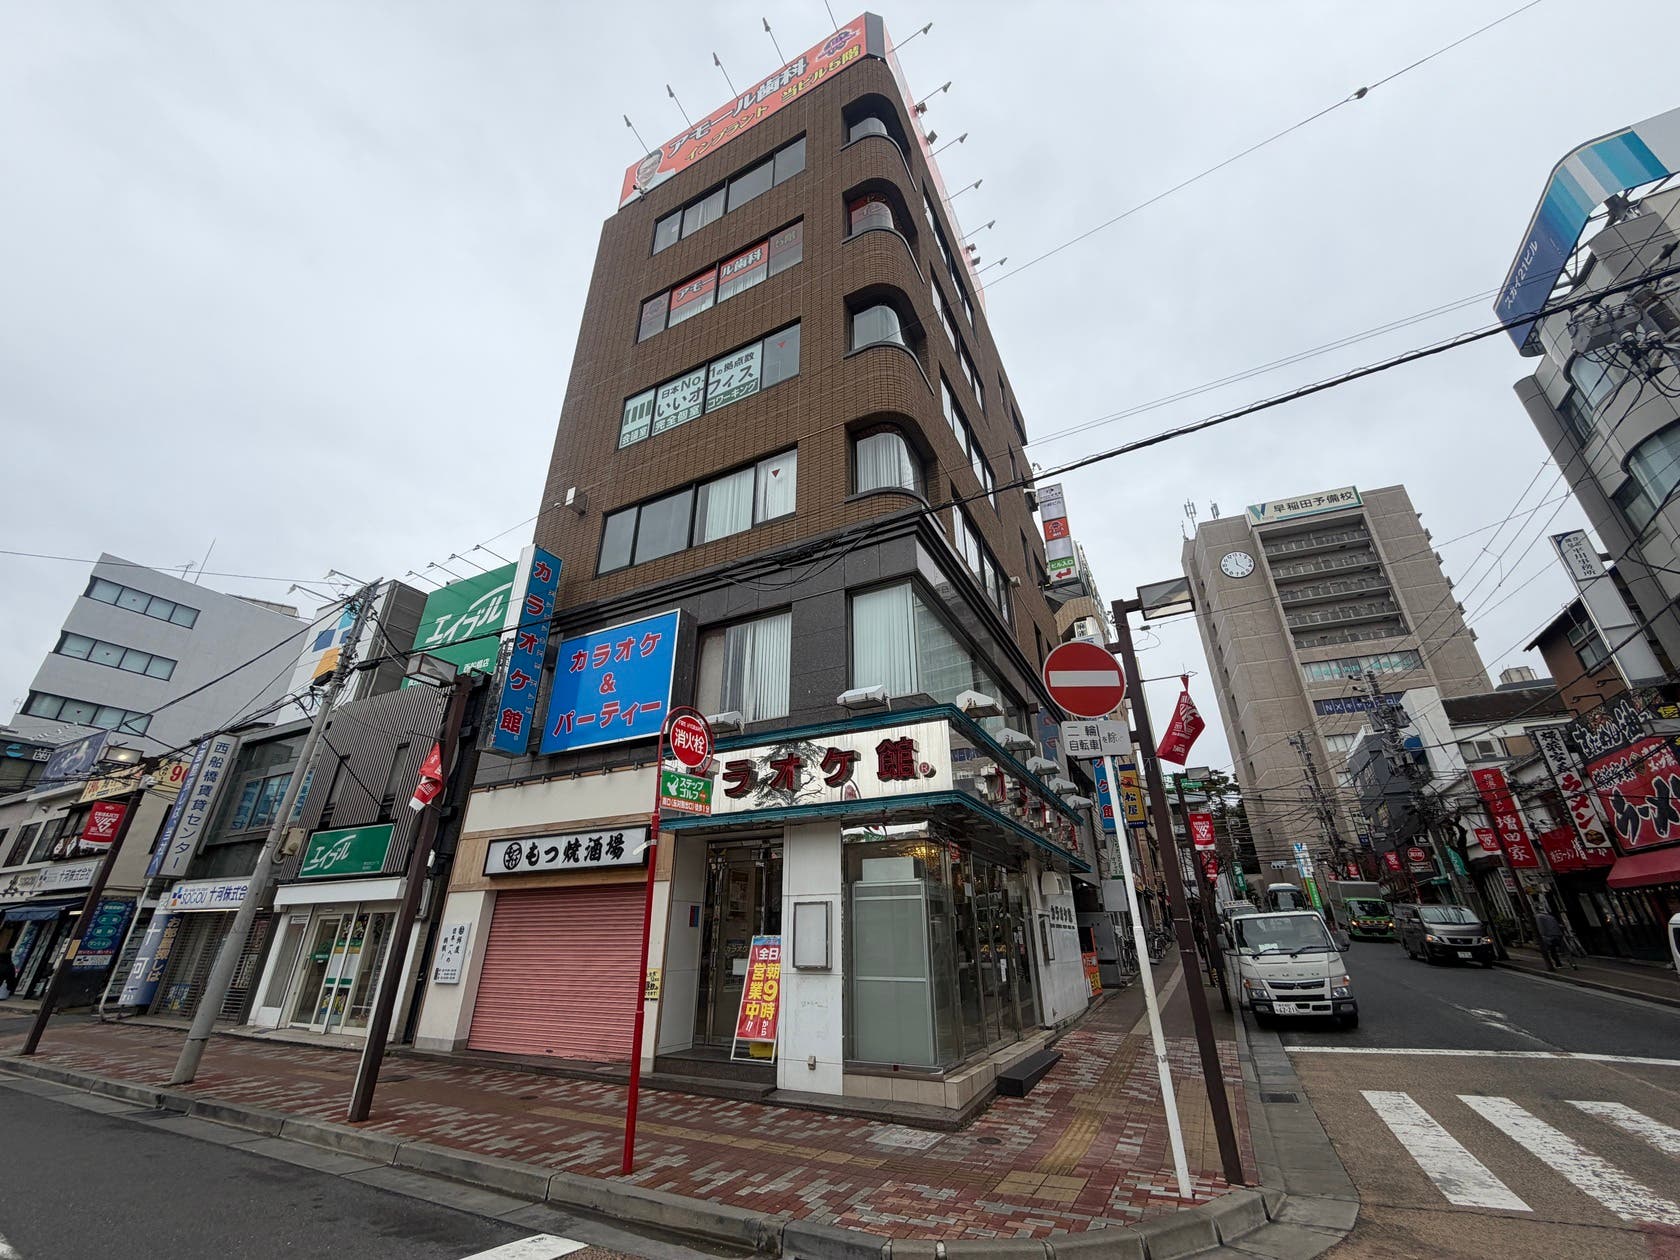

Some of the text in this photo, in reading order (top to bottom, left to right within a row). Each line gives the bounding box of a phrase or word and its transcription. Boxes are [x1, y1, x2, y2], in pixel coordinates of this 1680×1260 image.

[668, 56, 808, 158] アモール歯科
[687, 105, 769, 161] インプラント
[1504, 239, 1538, 310] スカイ21ビル
[1273, 491, 1354, 514] 早稲田予備校
[499, 561, 553, 735] カラオケ館
[569, 632, 662, 673] カラオケ
[599, 671, 617, 695] &
[552, 700, 662, 736] パーティー
[33, 747, 51, 762] 歯
[674, 728, 705, 755] 消火栓
[1069, 739, 1100, 752] 自転車
[680, 777, 704, 790] ステップ
[722, 736, 916, 799] ラオケ館
[173, 741, 230, 869] 西船橋賃貸センター
[680, 788, 699, 800] ゴルフ
[524, 832, 625, 867] もつ焼酒場
[758, 947, 779, 961] 全日
[760, 962, 780, 1036] 朝9時から
